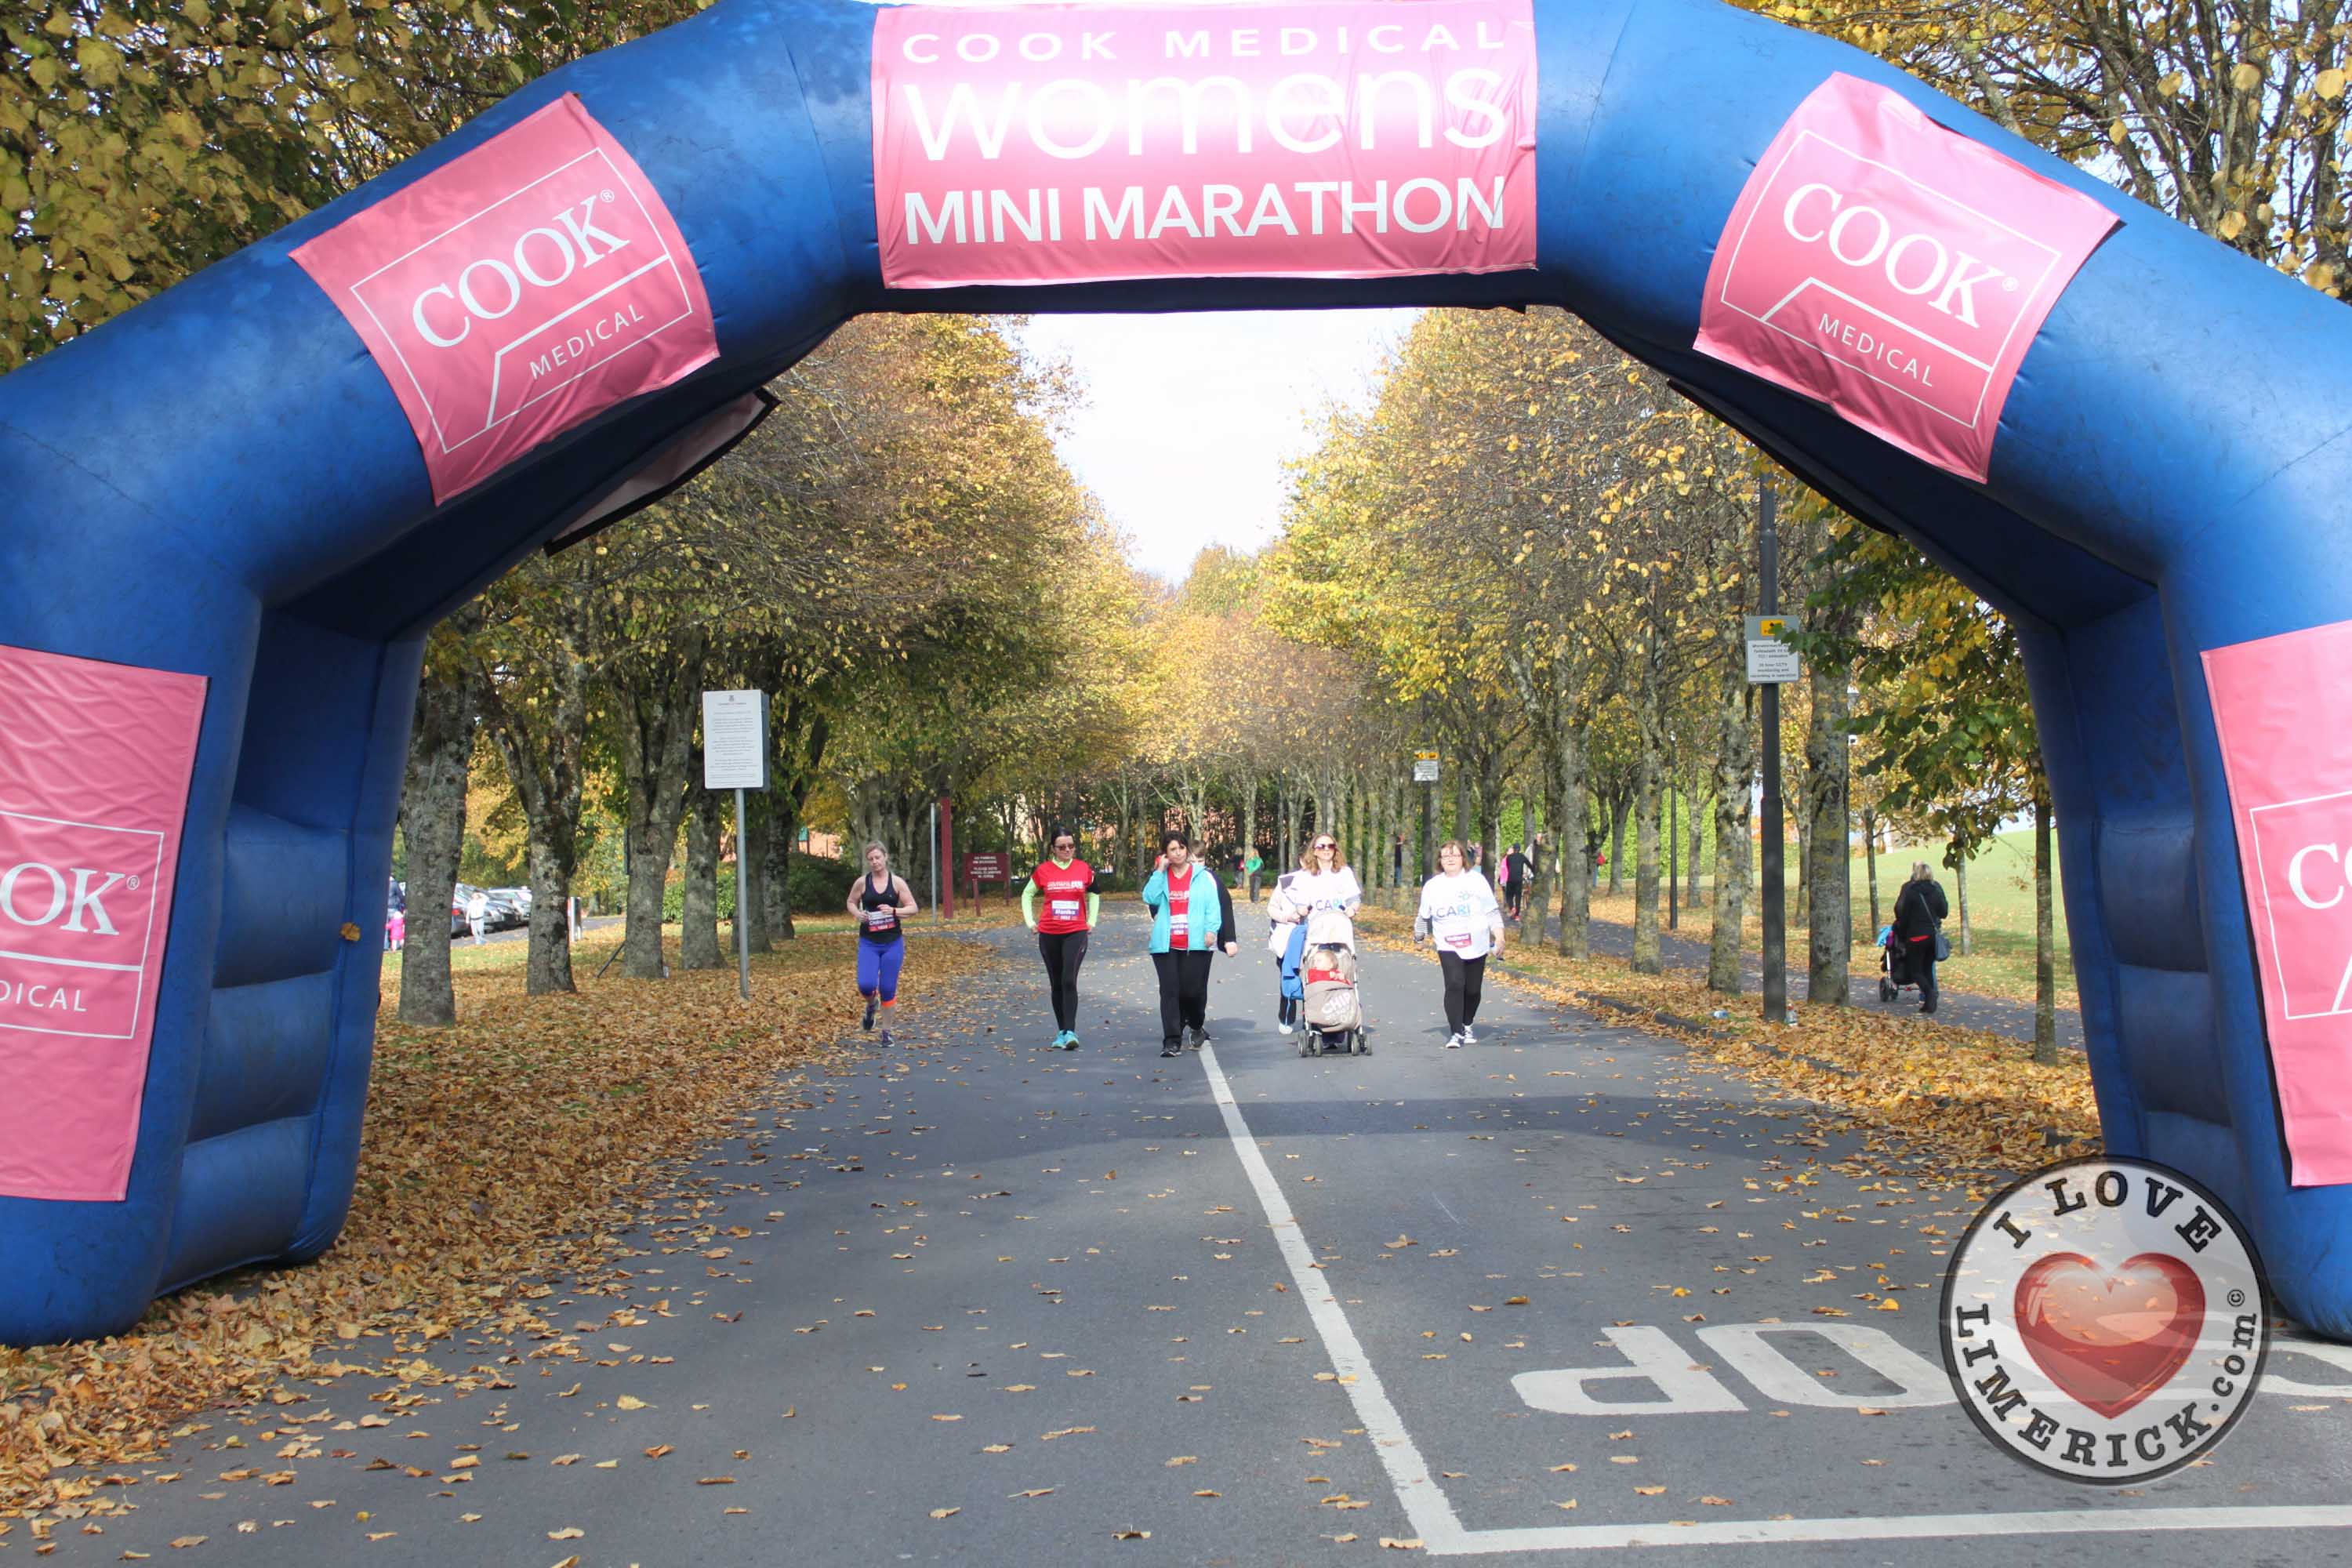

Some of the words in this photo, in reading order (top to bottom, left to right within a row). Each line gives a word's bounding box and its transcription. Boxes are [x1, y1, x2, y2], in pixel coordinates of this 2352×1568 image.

[902, 31, 1120, 64] COOK
[1164, 20, 1505, 60] MEDICAL
[902, 67, 1507, 162] womens
[904, 187, 1062, 245] MINI
[1083, 176, 1506, 241] MARATHON
[528, 303, 644, 380] MEDICAL
[1818, 313, 1933, 387] MEDICAL
